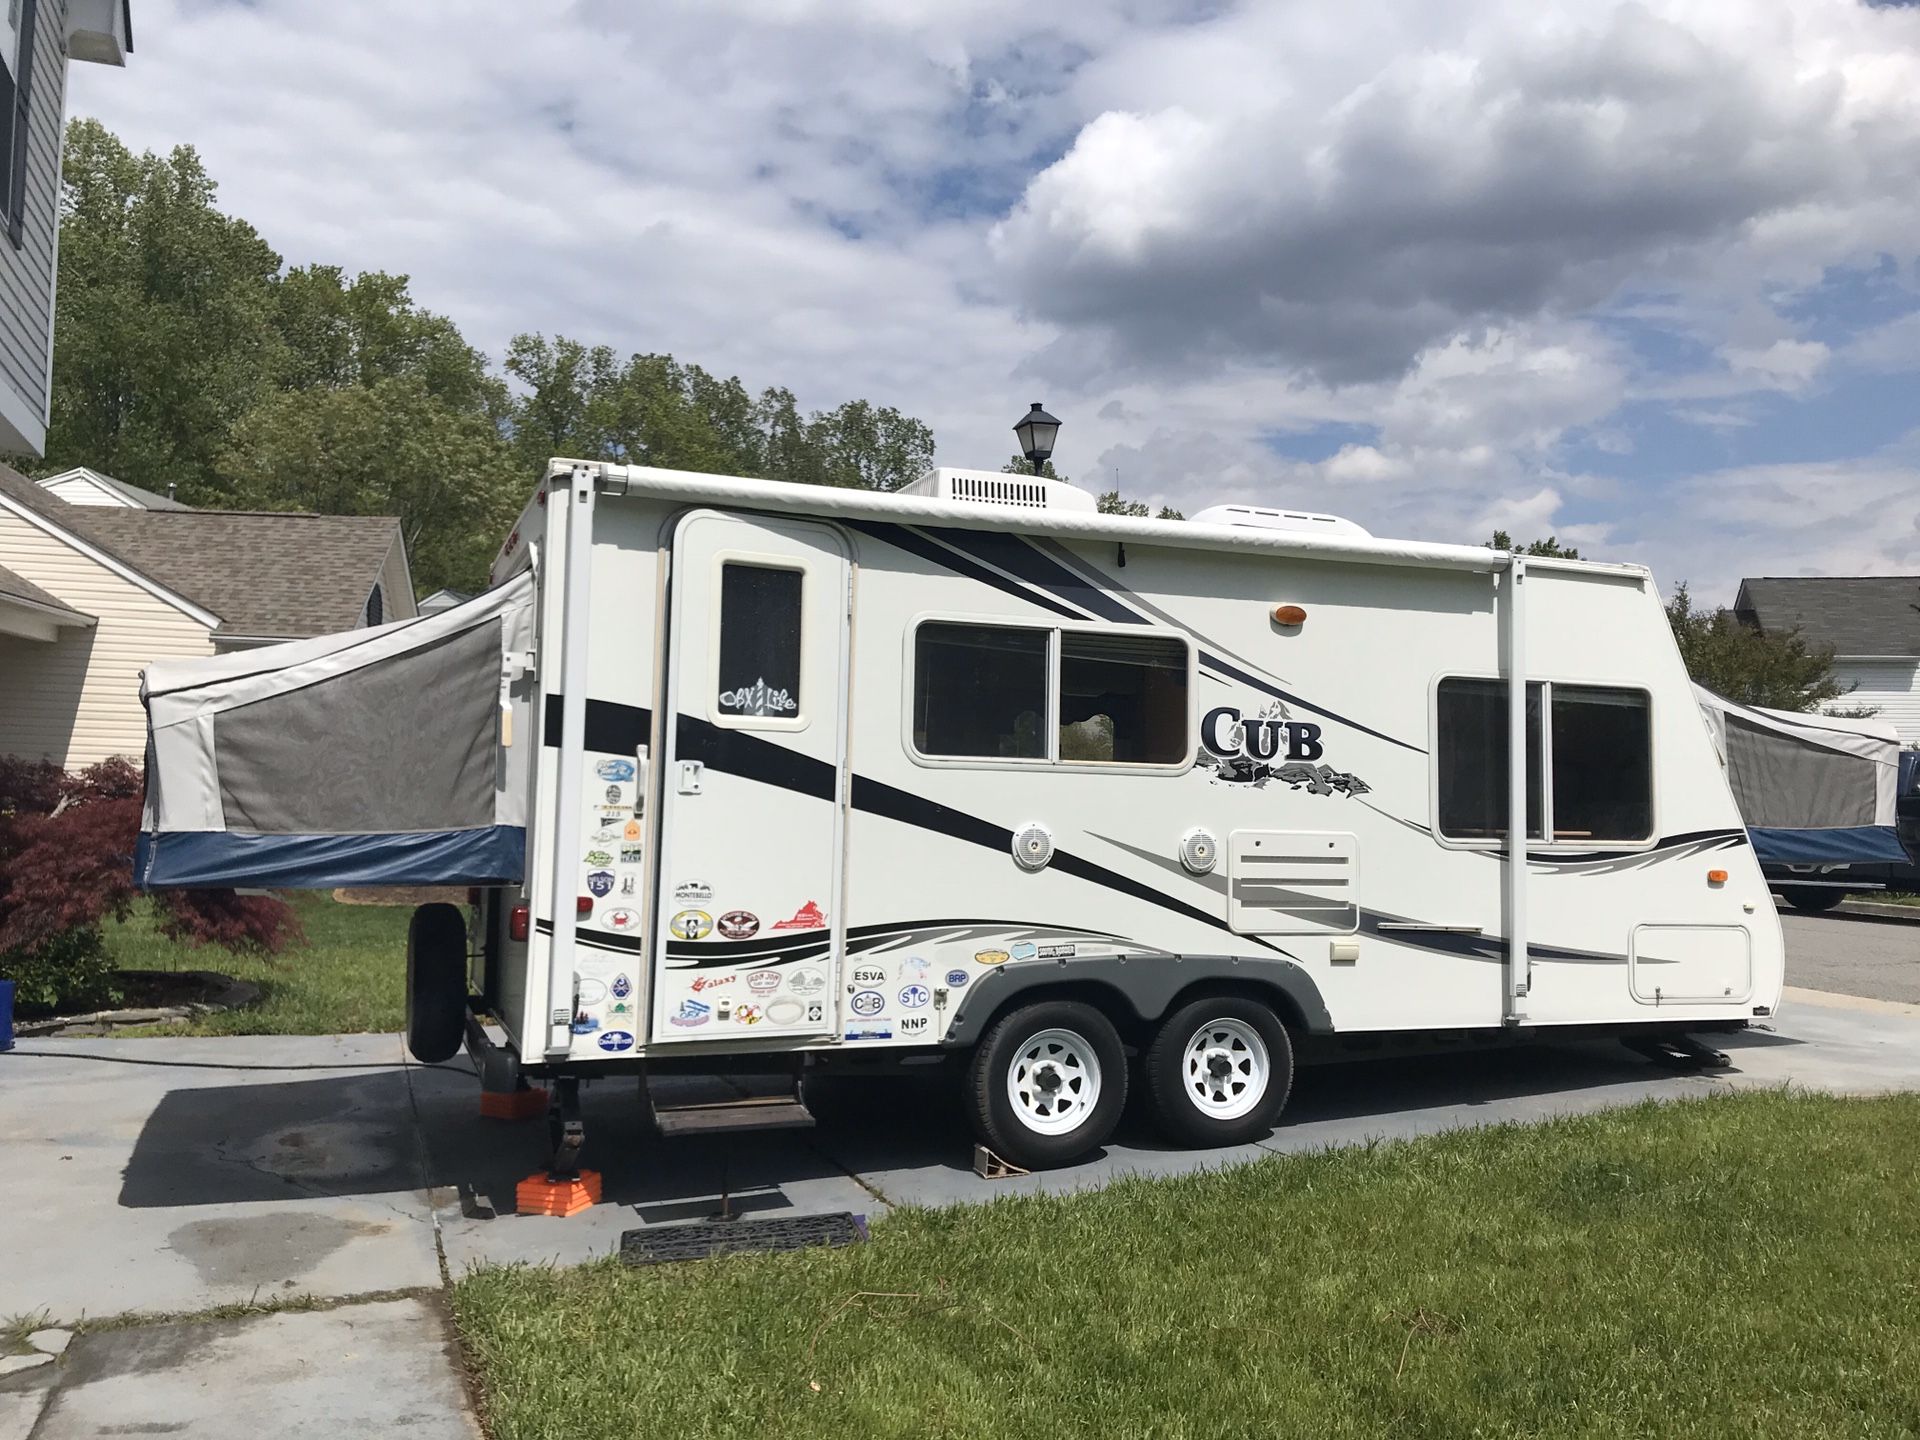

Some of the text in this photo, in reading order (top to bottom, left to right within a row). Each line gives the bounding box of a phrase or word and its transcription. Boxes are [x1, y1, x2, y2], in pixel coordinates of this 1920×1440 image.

[720, 688, 755, 709] OBX
[1201, 706, 1324, 761] CUB
[690, 975, 736, 992] Galaxy
[854, 971, 885, 981] ESVA
[949, 974, 966, 983] BRP
[901, 1017, 928, 1030] NNP
